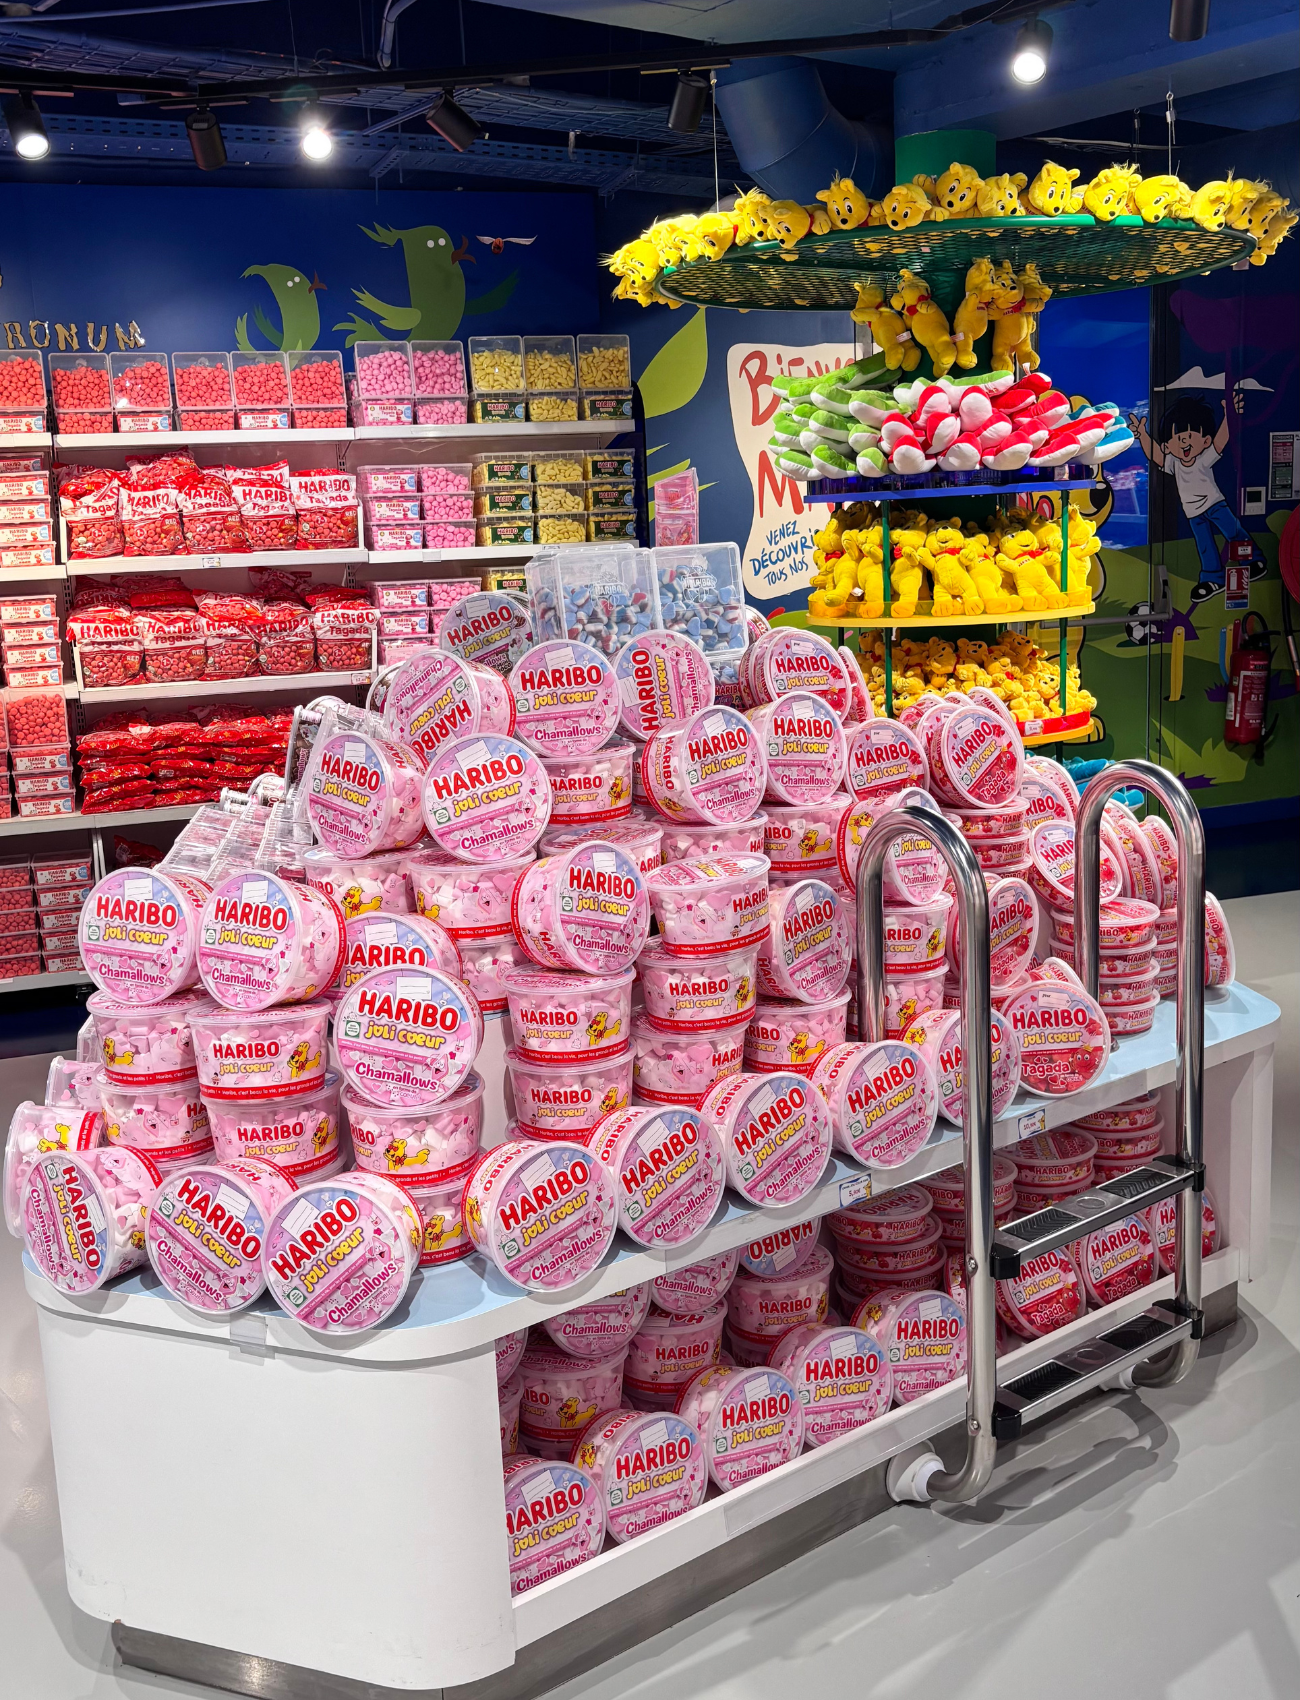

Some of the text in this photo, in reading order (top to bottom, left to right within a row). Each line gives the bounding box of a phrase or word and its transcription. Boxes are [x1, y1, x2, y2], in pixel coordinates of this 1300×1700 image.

[299, 479, 351, 493] HARIBO
[86, 501, 117, 515] Tagad
[766, 520, 800, 547] VENEZ
[750, 528, 815, 576] DÉCOUVRi
[764, 556, 808, 586] TOUS NOS
[320, 612, 375, 624] HARIBO
[329, 626, 369, 637] Tagada
[447, 606, 513, 646] HARIBO
[81, 625, 140, 639] HARIBO
[775, 654, 831, 674] HARIBO
[395, 659, 443, 704] Chamallows
[520, 666, 602, 691] HARIBO
[632, 649, 660, 733] HARIBO
[715, 684, 740, 696] HARIB
[533, 690, 598, 710] joli coeur
[534, 725, 601, 740] Chamallows
[774, 716, 833, 739] HARIBO
[688, 729, 748, 762] HARIBO
[855, 742, 910, 769] HARIBO
[952, 721, 994, 769] HARIBO
[321, 752, 380, 792] HARIBO
[433, 754, 524, 799] HARIBO
[661, 736, 676, 790] HARIBO
[550, 776, 603, 791] HARIBO
[781, 774, 830, 787] Chamallows
[980, 770, 1007, 800] Tagada
[453, 781, 522, 816] joli coeur
[706, 790, 755, 810] Chamallows
[1026, 795, 1055, 815] RIBO
[318, 815, 367, 842] Chamallows
[461, 819, 534, 850] Chamallows
[1040, 839, 1075, 863] HARI
[307, 878, 334, 895] RIBO
[569, 866, 635, 899] HARIBO
[903, 874, 938, 886] Chamallows
[97, 896, 177, 927] HARIBO
[215, 899, 288, 931] HARIBO
[783, 900, 834, 942] HARIBO
[991, 898, 1025, 933] ARIBO
[103, 924, 168, 945] joli coeur
[573, 934, 629, 954] Chamallows
[99, 964, 165, 985] Chamallows
[212, 968, 272, 991] Chamallows
[669, 979, 729, 996] HARIBO
[801, 961, 842, 989] Chamallows
[358, 991, 458, 1031] HARIBO
[676, 997, 725, 1010] joli coeur
[520, 1009, 577, 1026] HARIBO
[1012, 1008, 1088, 1030] HARIBO
[365, 1021, 396, 1039] joli
[398, 1030, 445, 1049] coeur
[526, 1028, 573, 1039] joli coeur
[1023, 1031, 1083, 1048] joli coeur
[213, 1041, 280, 1059] HARIBO
[220, 1061, 274, 1075] joli coeur
[355, 1063, 438, 1090] Chamallows
[1021, 1061, 1070, 1078] Tagada
[531, 1088, 592, 1106] HARIBO
[848, 1058, 915, 1113] HARIBO
[865, 1084, 916, 1128] joli coeur
[237, 1122, 304, 1141] HARIBO
[734, 1087, 806, 1155] HARIBO
[871, 1117, 926, 1159] Chamallows
[621, 1123, 698, 1194] HARIBO
[765, 1146, 820, 1198] Chamallows
[1035, 1165, 1069, 1175] HARIBO
[499, 1161, 590, 1231] HARIBO
[62, 1165, 101, 1269] HARIBO
[177, 1177, 261, 1259] HARIBO
[522, 1217, 548, 1246] joli
[550, 1191, 588, 1223] coeur
[654, 1184, 714, 1239] Chamallows
[30, 1188, 58, 1273] Chamallows
[174, 1210, 241, 1268] joli coeur
[892, 1219, 923, 1232] HARIBO
[271, 1199, 358, 1281] HARIBO
[1091, 1223, 1139, 1260] HARIBO
[300, 1260, 329, 1293] joli
[327, 1228, 365, 1266] coeur
[532, 1229, 602, 1281] Chamallows
[1102, 1246, 1139, 1275] joli coeur
[157, 1239, 223, 1302] Chamallows
[328, 1263, 397, 1323] Chamallows
[654, 1276, 713, 1297] Chamallows
[1105, 1277, 1137, 1299] Tagada
[759, 1297, 812, 1314] HARIBO
[1033, 1304, 1064, 1325] Tagada
[562, 1324, 627, 1337] Chamallows
[896, 1318, 959, 1340] HARIBO
[656, 1341, 709, 1360] HARIBO
[805, 1353, 878, 1382] HARIBO
[899, 1379, 951, 1392] Chamallow
[722, 1393, 790, 1428] HARIBO
[731, 1421, 784, 1448] joli coeur
[810, 1417, 873, 1435] Chamallow
[615, 1437, 691, 1480] HARIBO
[627, 1466, 686, 1499] joli coeur
[514, 1512, 580, 1556] joli coeur
[516, 1552, 587, 1592] Chamallows
